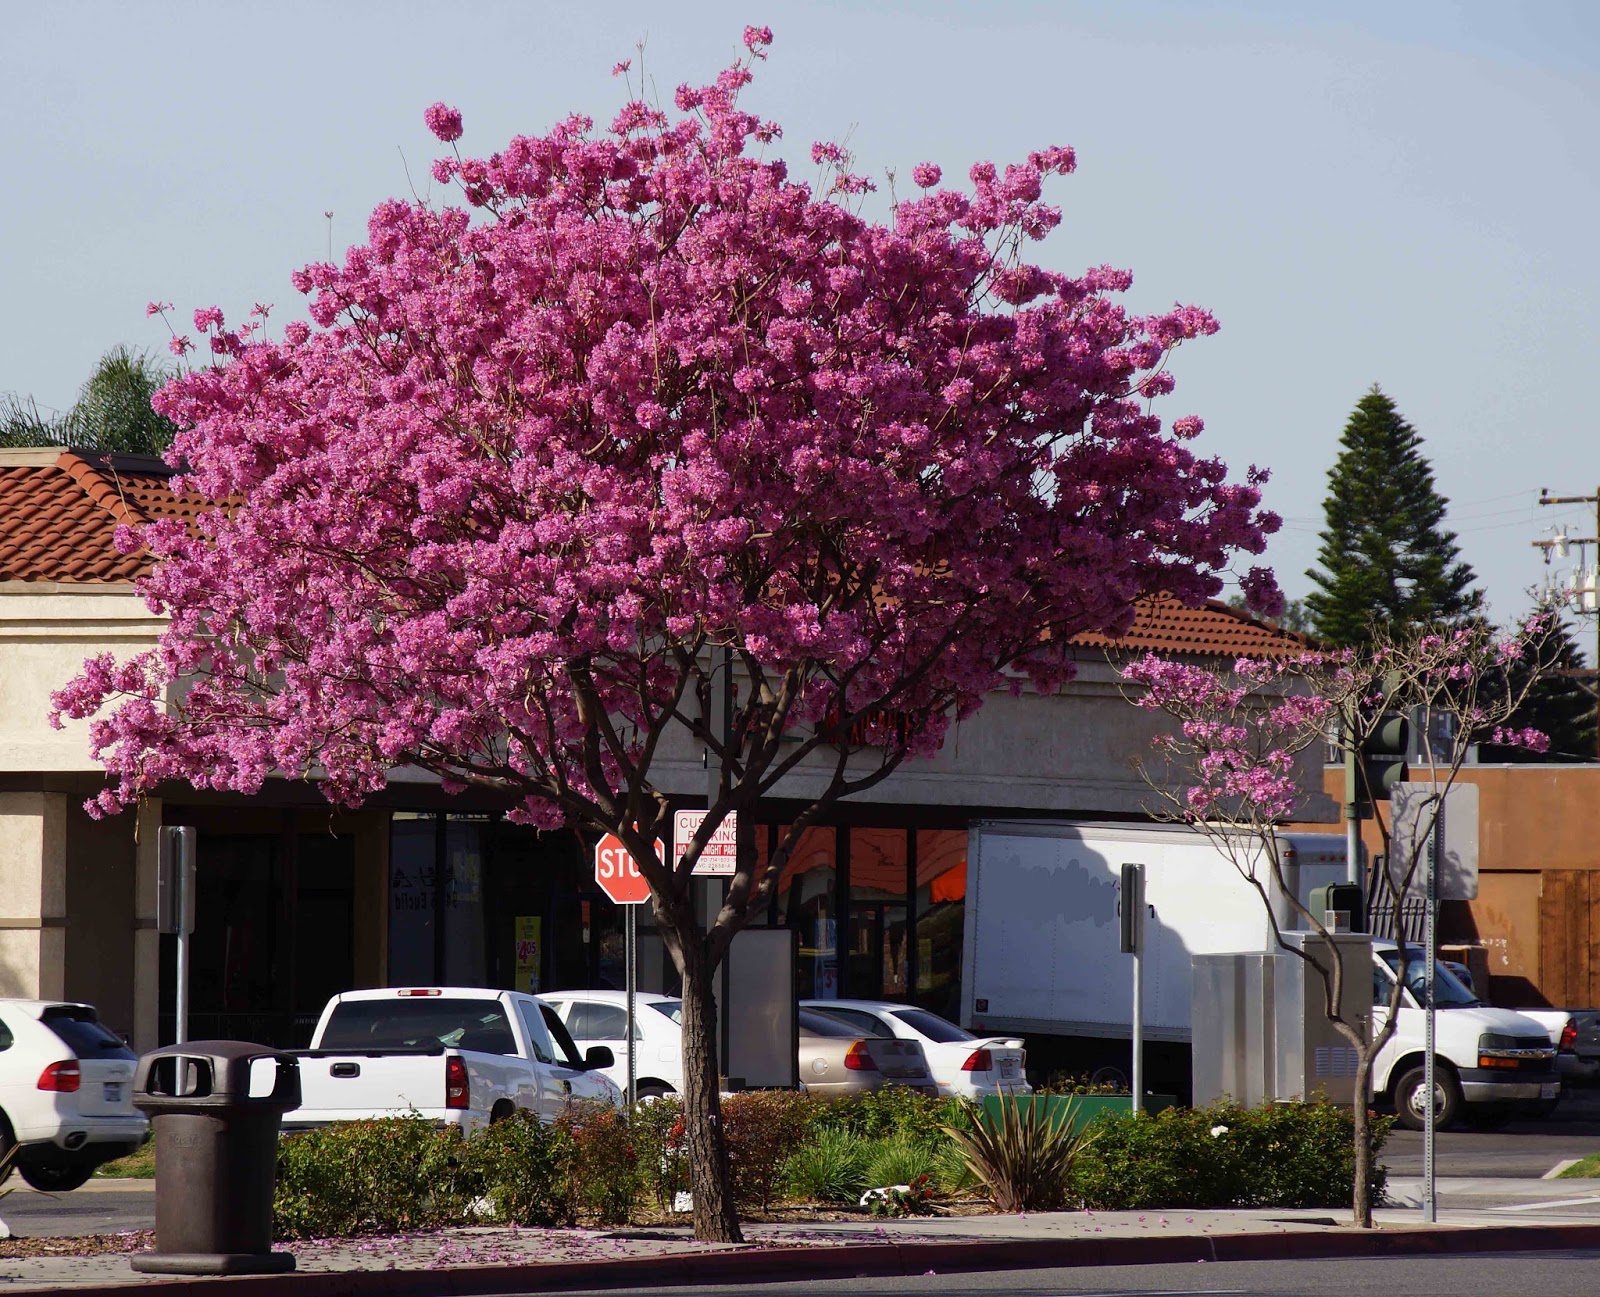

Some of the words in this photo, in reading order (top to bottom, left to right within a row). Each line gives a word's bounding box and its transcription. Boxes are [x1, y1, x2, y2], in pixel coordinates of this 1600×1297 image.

[688, 830, 737, 841] PKIN
[677, 844, 687, 855] NO
[600, 848, 661, 878] STO
